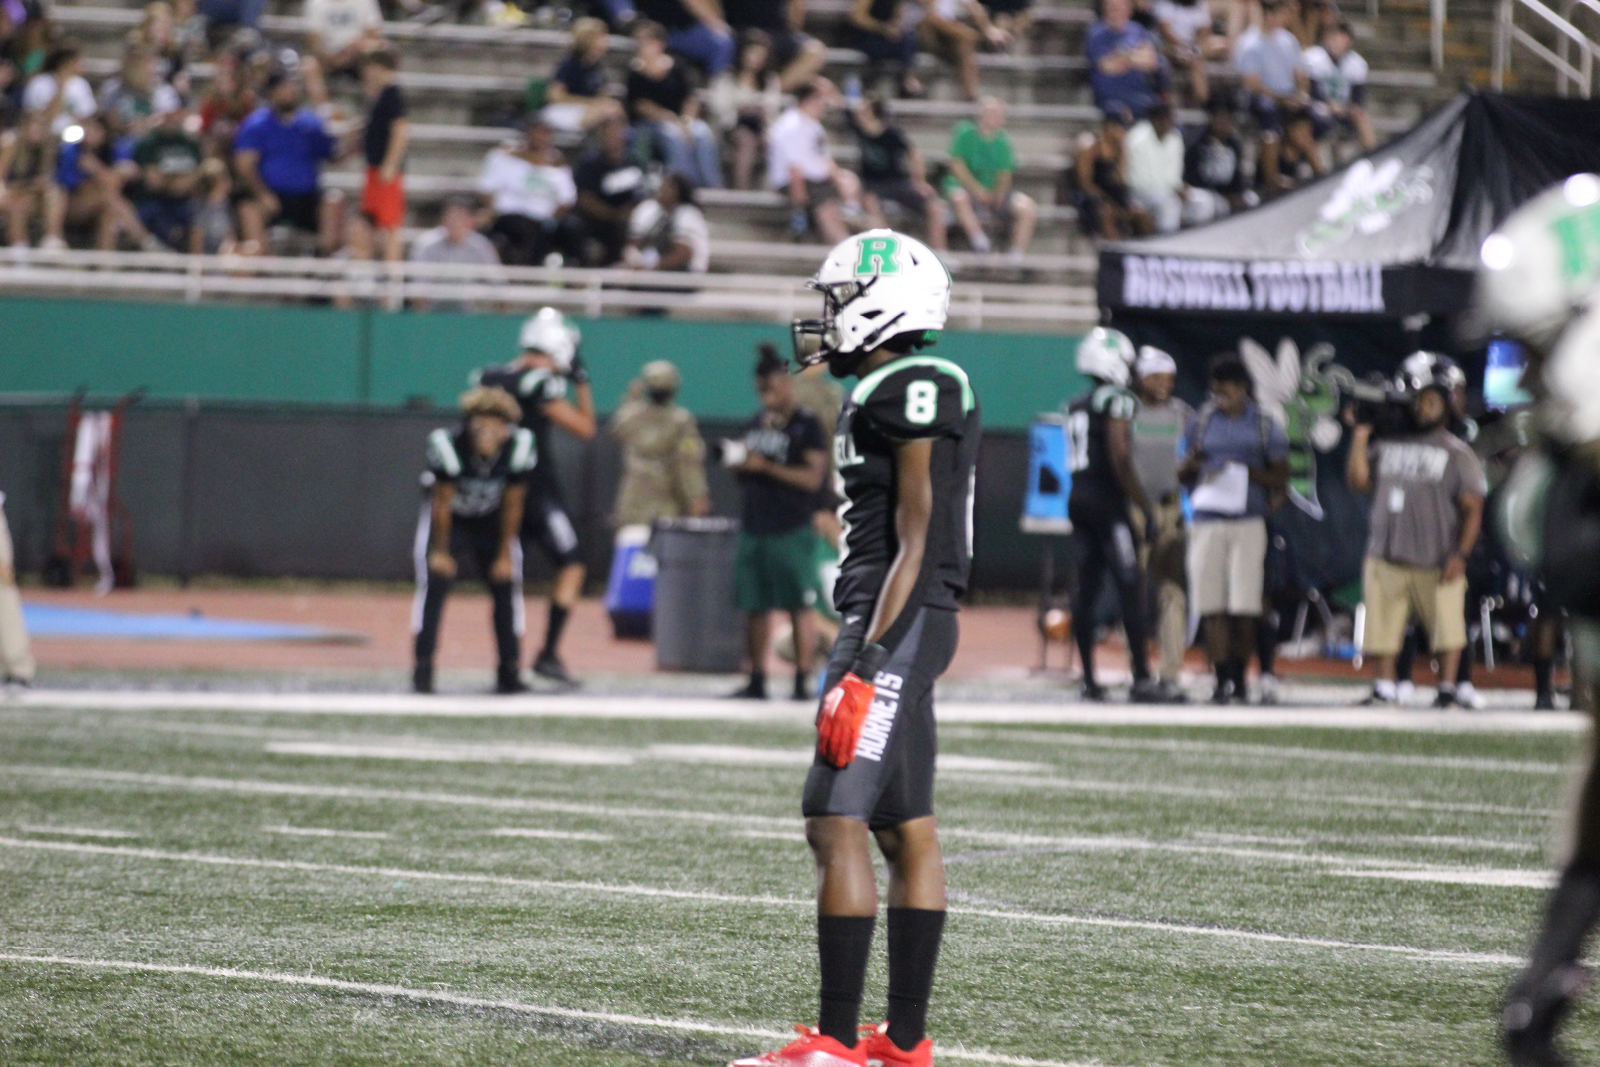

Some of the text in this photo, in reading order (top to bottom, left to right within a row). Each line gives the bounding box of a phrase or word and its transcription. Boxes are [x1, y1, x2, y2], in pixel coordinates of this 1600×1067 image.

[854, 235, 902, 276] R
[1250, 259, 1386, 313] FOOTBALL
[905, 380, 938, 424] 8
